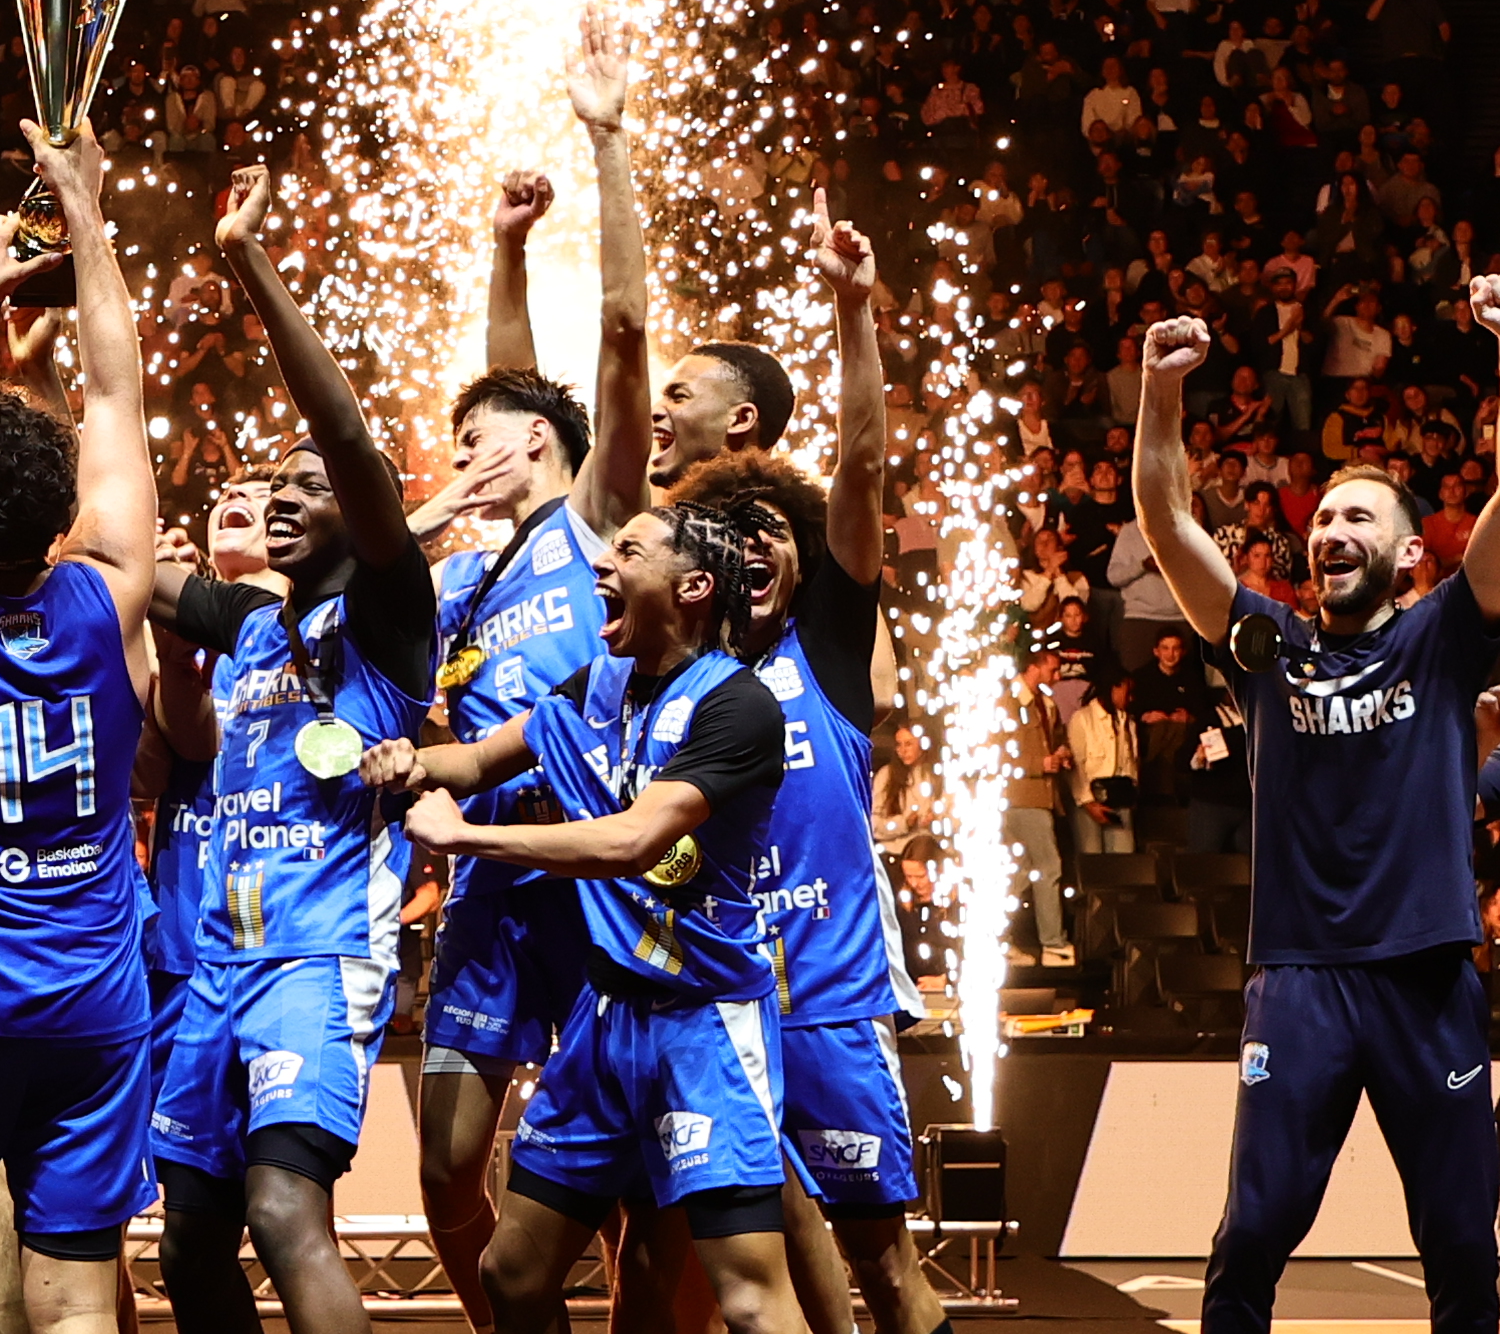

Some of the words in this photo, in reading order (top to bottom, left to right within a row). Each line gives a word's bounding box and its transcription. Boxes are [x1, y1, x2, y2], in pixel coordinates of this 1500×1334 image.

[532, 545, 572, 569] KING
[494, 655, 527, 701] 5
[1288, 679, 1417, 735] SHARKS
[246, 719, 271, 768] 7
[216, 781, 282, 818] ravel
[223, 819, 326, 851] Planet
[36, 860, 98, 880] Emotion
[756, 877, 829, 914] anet
[808, 1141, 874, 1164] SNCF
